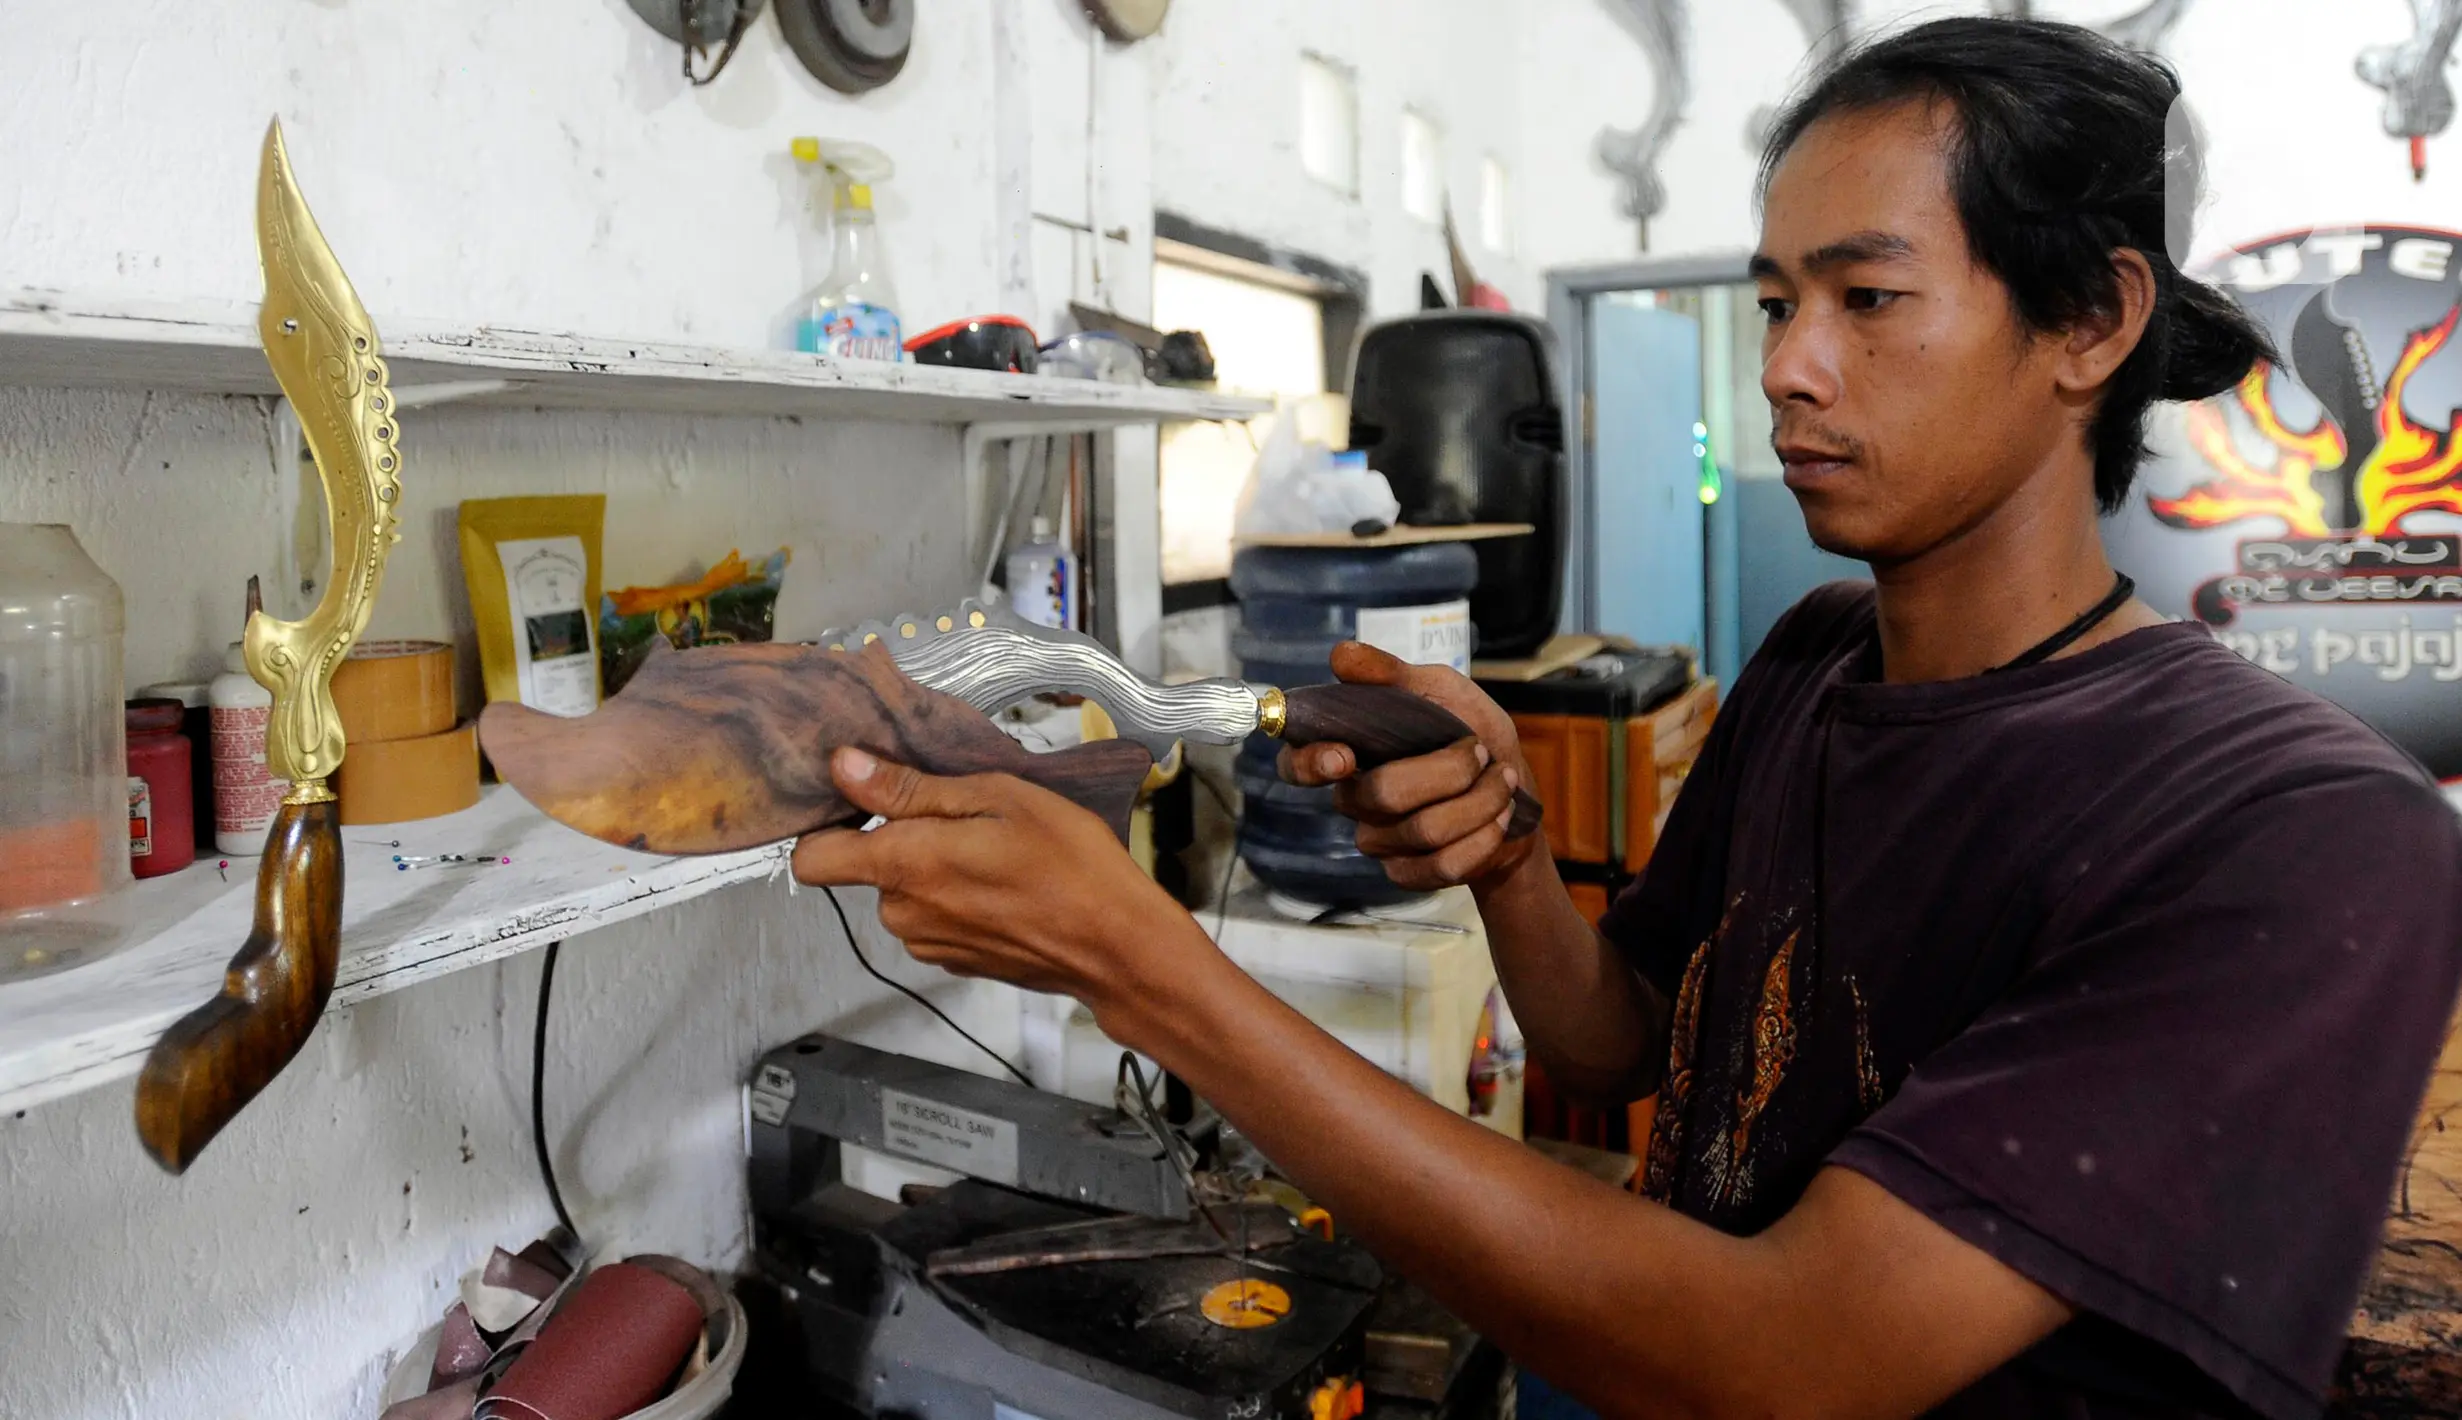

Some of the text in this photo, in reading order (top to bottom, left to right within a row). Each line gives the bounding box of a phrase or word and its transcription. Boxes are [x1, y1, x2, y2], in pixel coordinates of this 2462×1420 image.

[2228, 233, 2462, 292] UTE
[914, 1105, 963, 1130] SCROLL
[967, 1120, 996, 1139] SAW
